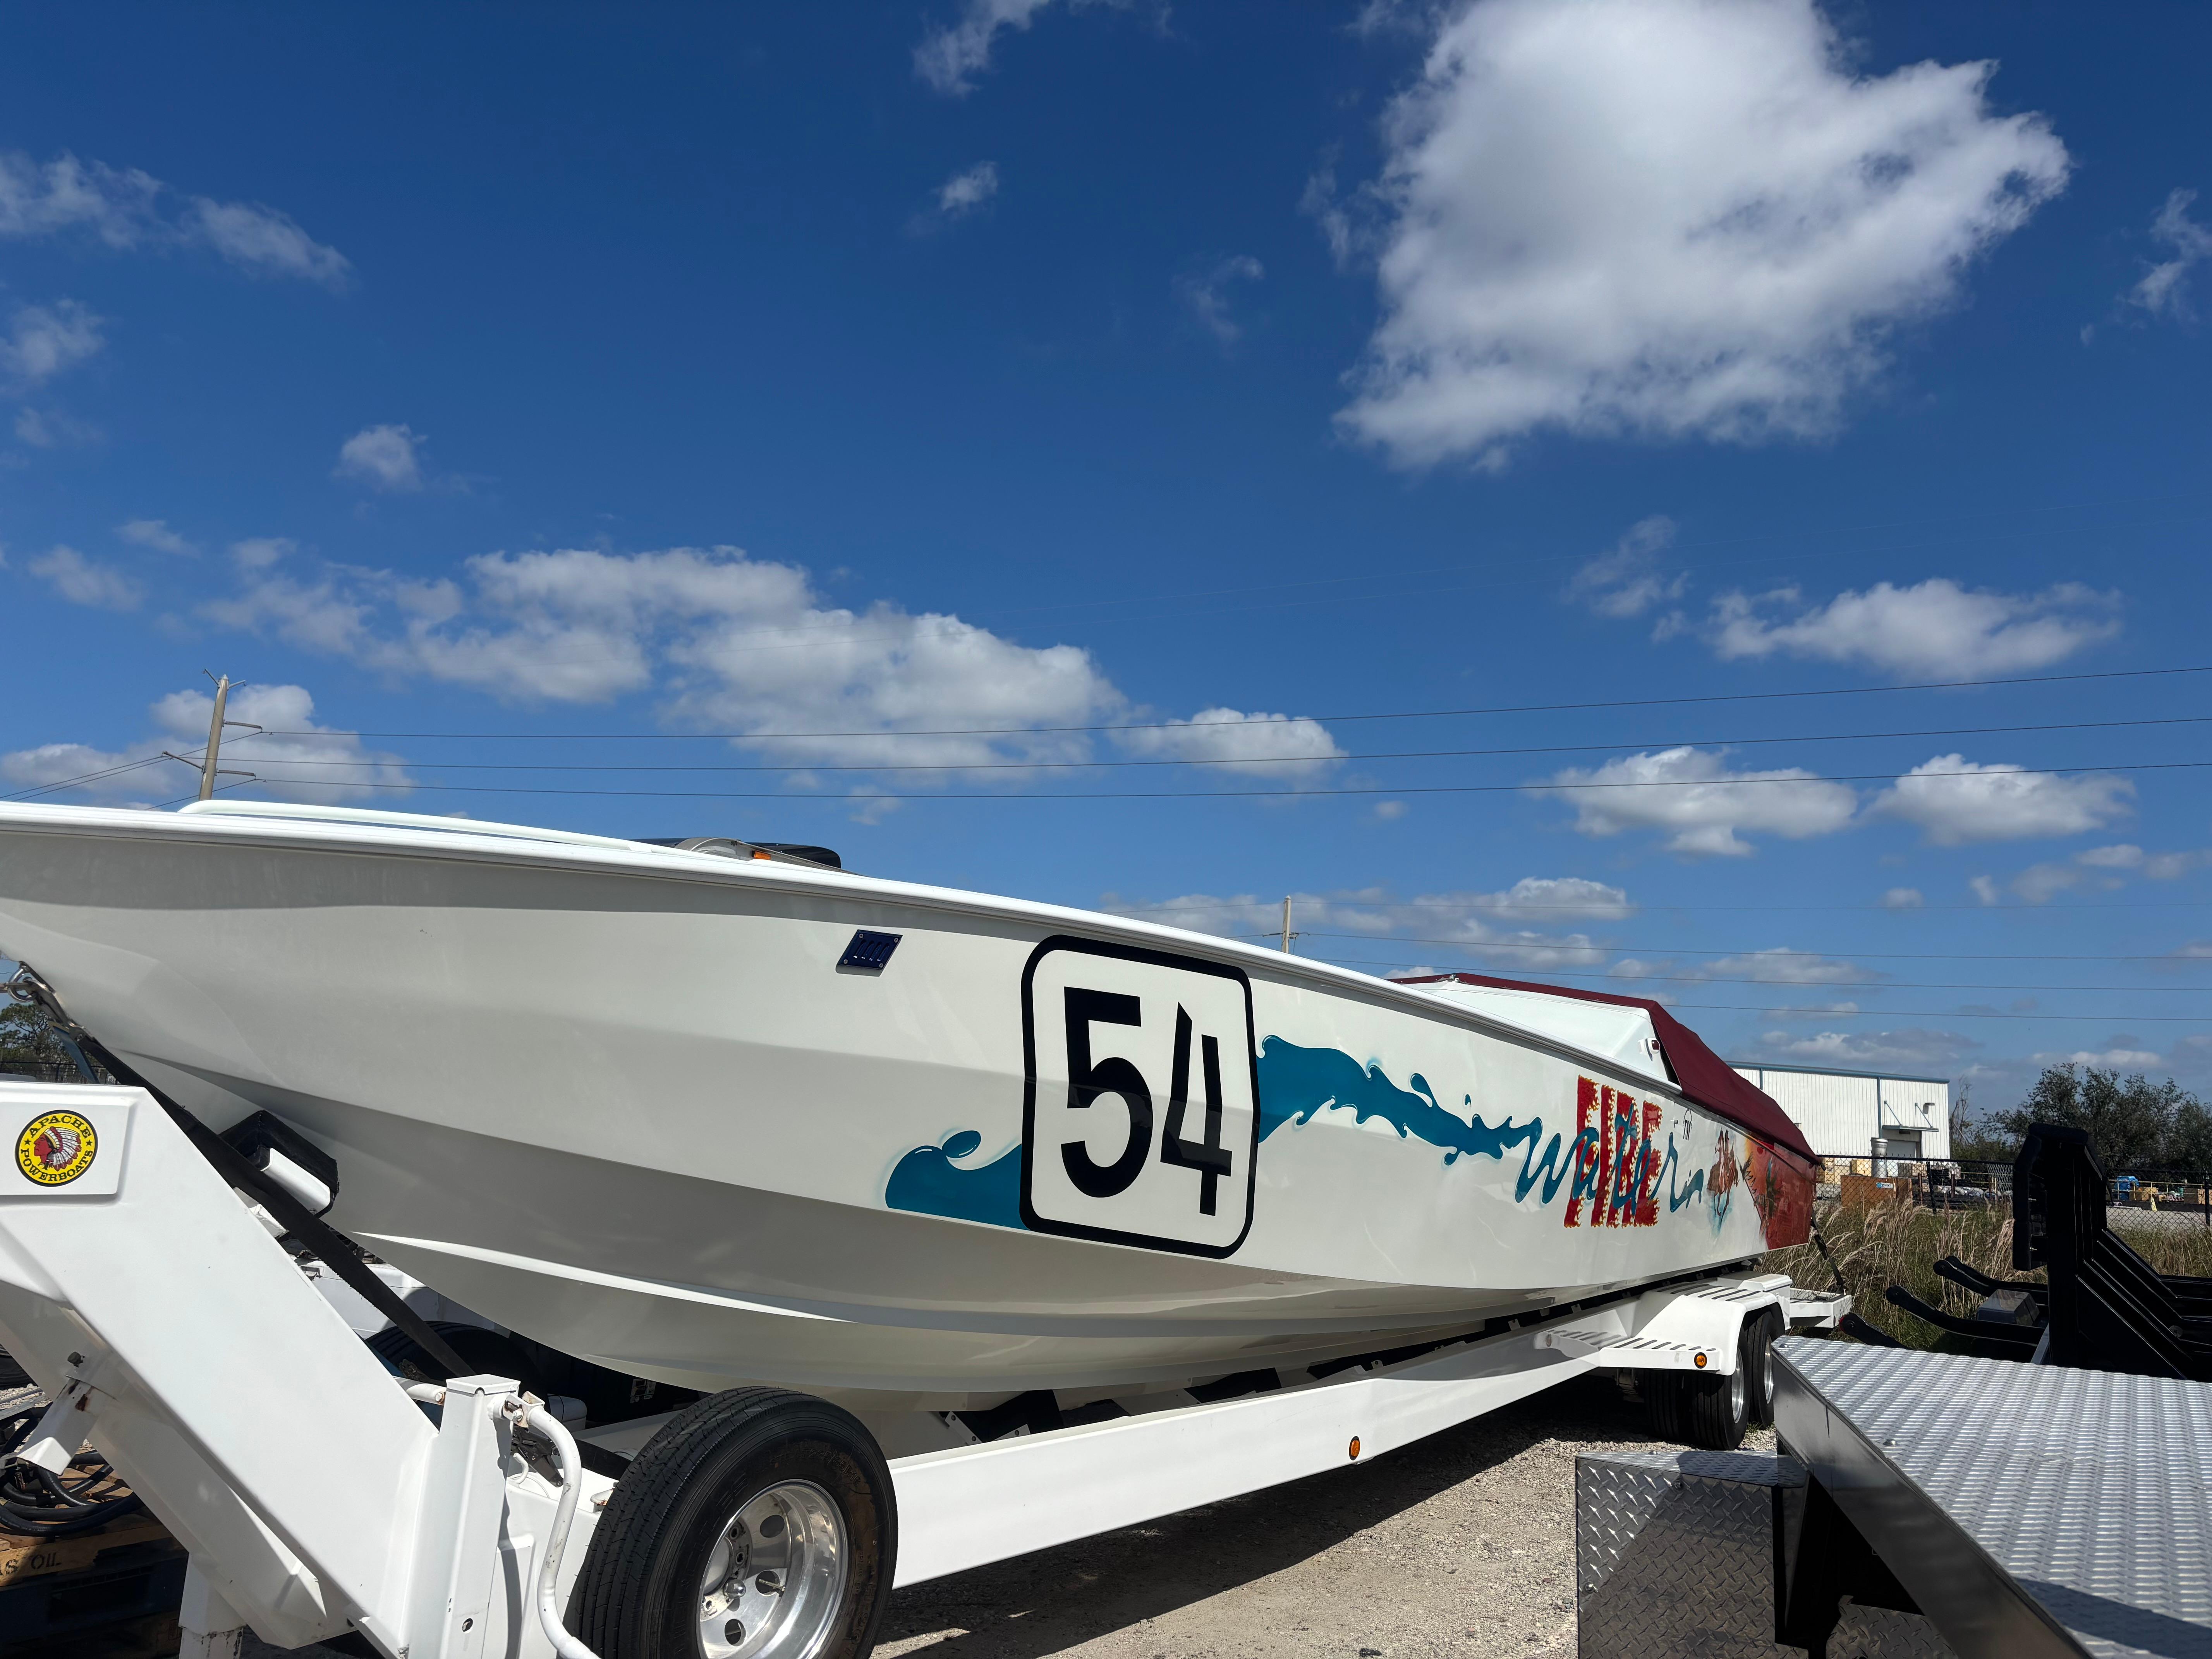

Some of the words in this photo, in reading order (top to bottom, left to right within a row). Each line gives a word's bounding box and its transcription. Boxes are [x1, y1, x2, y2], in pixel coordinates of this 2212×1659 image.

[1061, 986, 1232, 1216] 54
[29, 1115, 92, 1139] APACHE
[21, 1148, 93, 1181] POWERBOATS
[1563, 1074, 1663, 1229] FIRE
[31, 1552, 62, 1569] OIL
